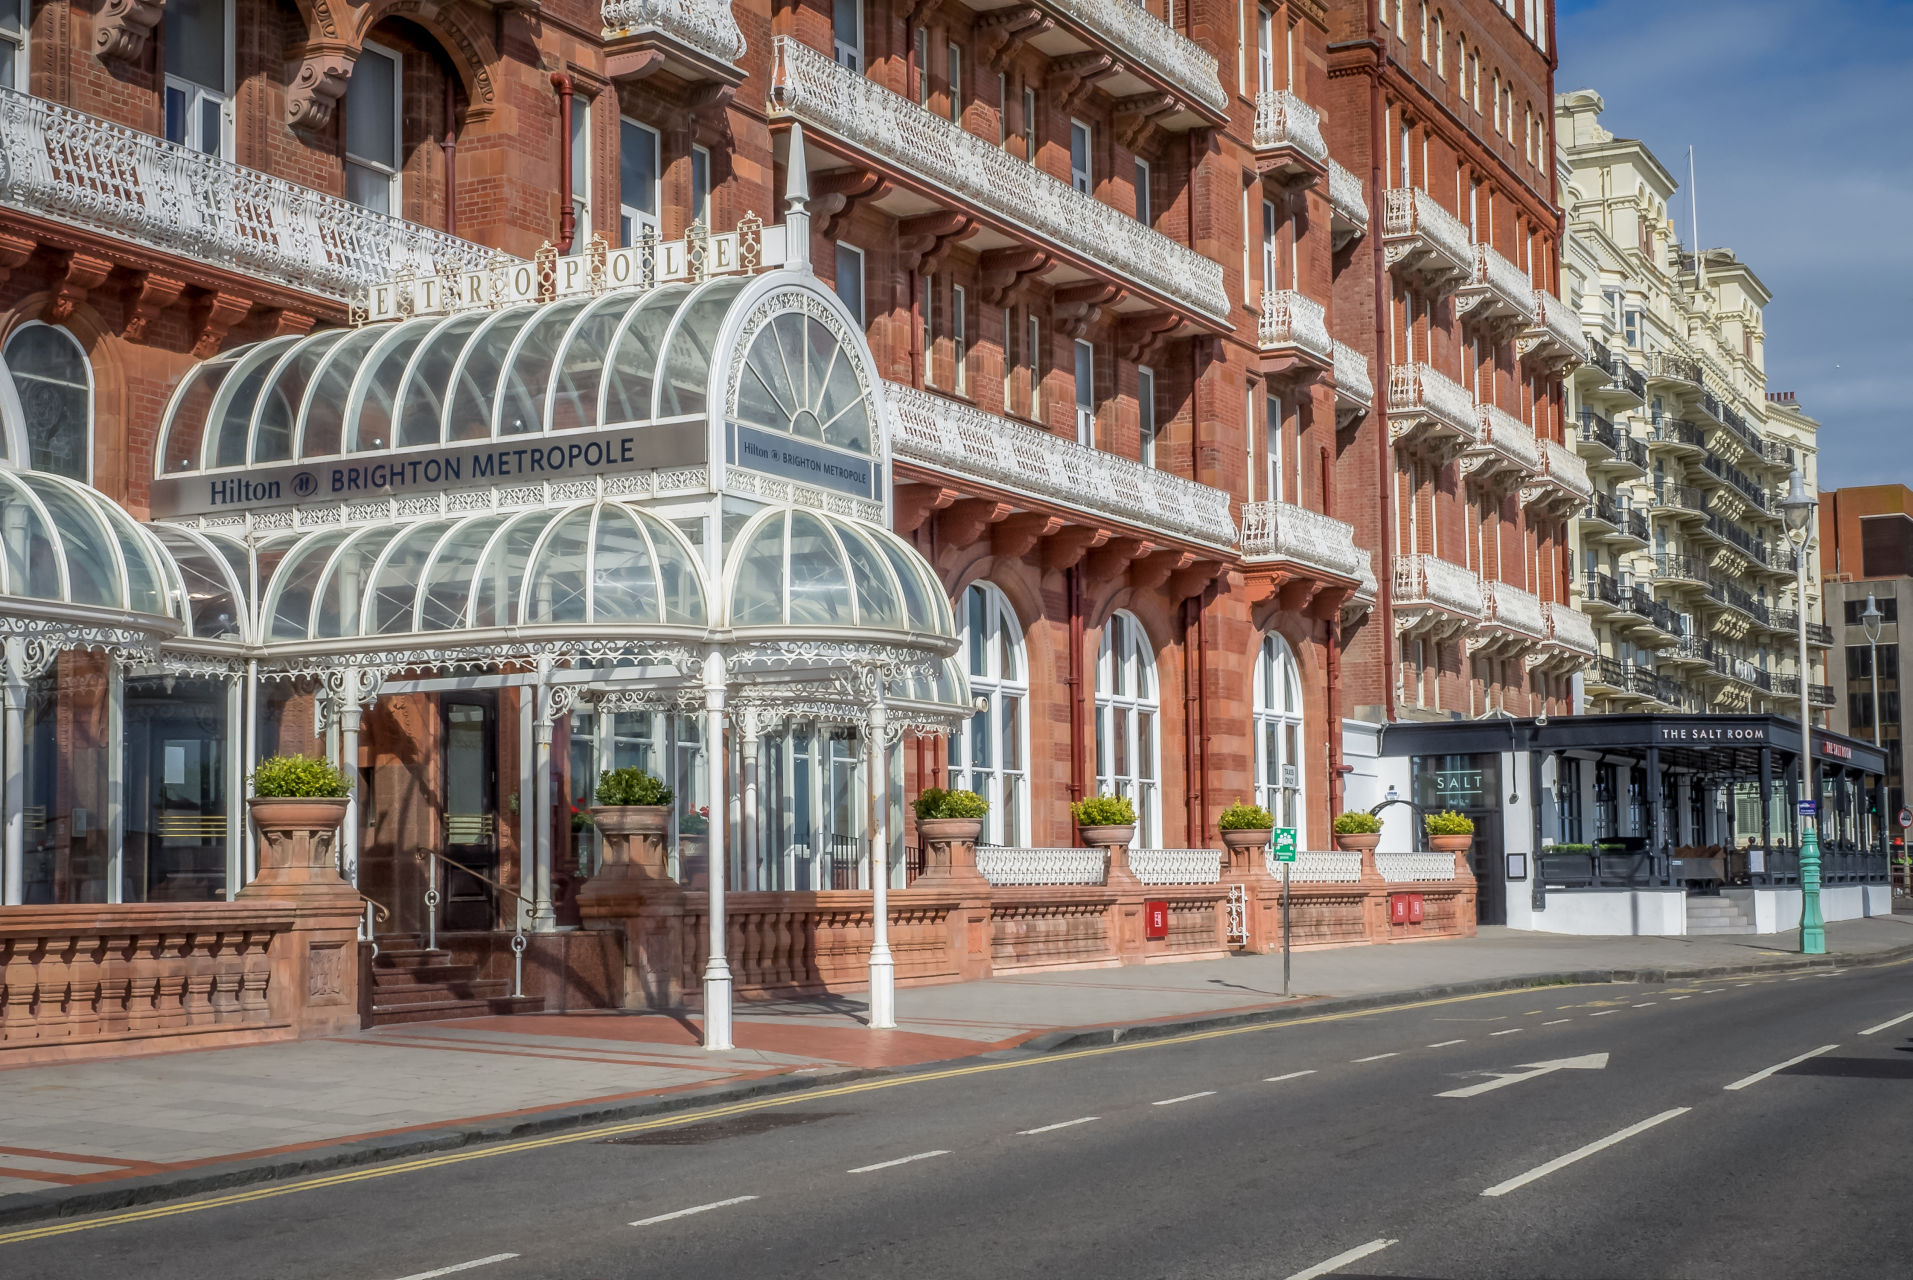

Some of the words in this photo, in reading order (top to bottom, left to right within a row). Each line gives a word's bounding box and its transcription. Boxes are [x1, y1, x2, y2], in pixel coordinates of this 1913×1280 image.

[376, 237, 731, 316] ETROPOLE
[209, 480, 281, 505] Hilton
[331, 457, 461, 491] BRIGHTON
[472, 438, 635, 478] METROPOLE
[744, 442, 768, 459] Hilton
[782, 452, 822, 472] BRIGHTON
[823, 464, 867, 484] METROPOLE
[1662, 729, 1686, 739] THE
[1692, 729, 1722, 739] SALT
[1727, 729, 1764, 739] ROOM
[1436, 776, 1482, 789] SALT
